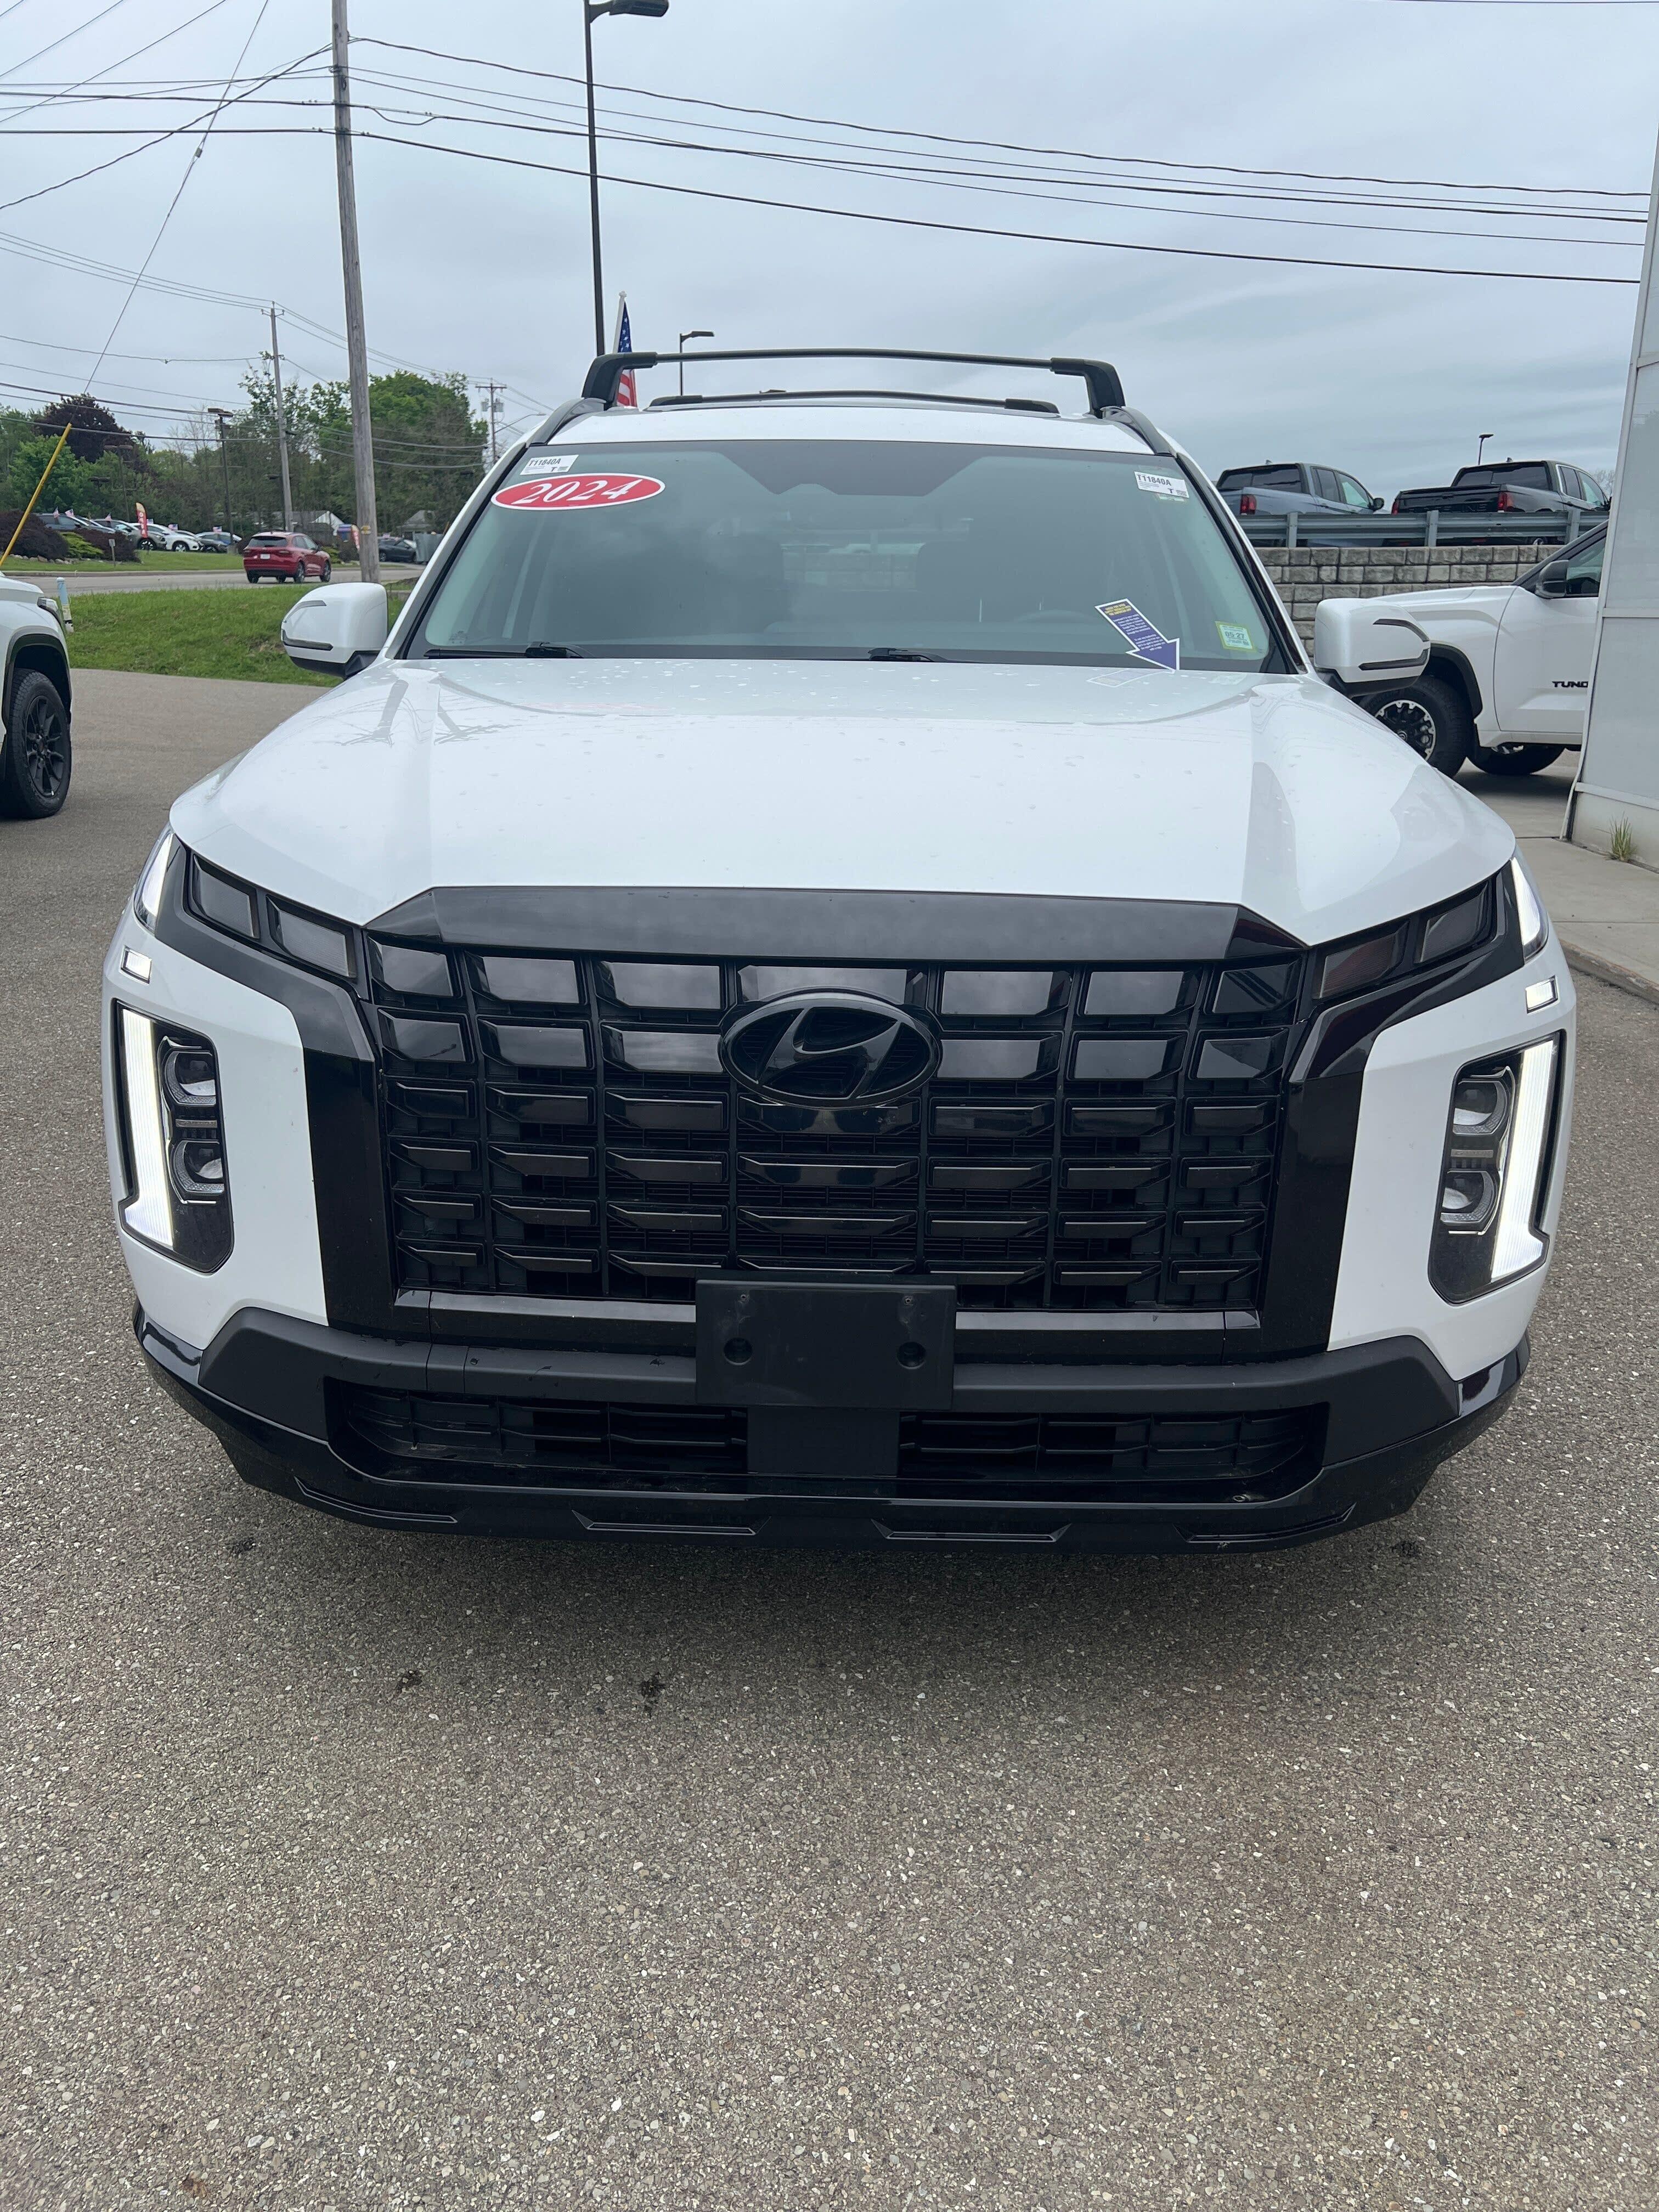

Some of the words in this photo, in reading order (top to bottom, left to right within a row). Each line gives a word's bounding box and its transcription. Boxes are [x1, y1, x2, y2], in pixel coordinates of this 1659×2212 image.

[528, 458, 561, 466] T11840A
[1137, 474, 1172, 486] T11840A
[511, 479, 643, 504] 2024
